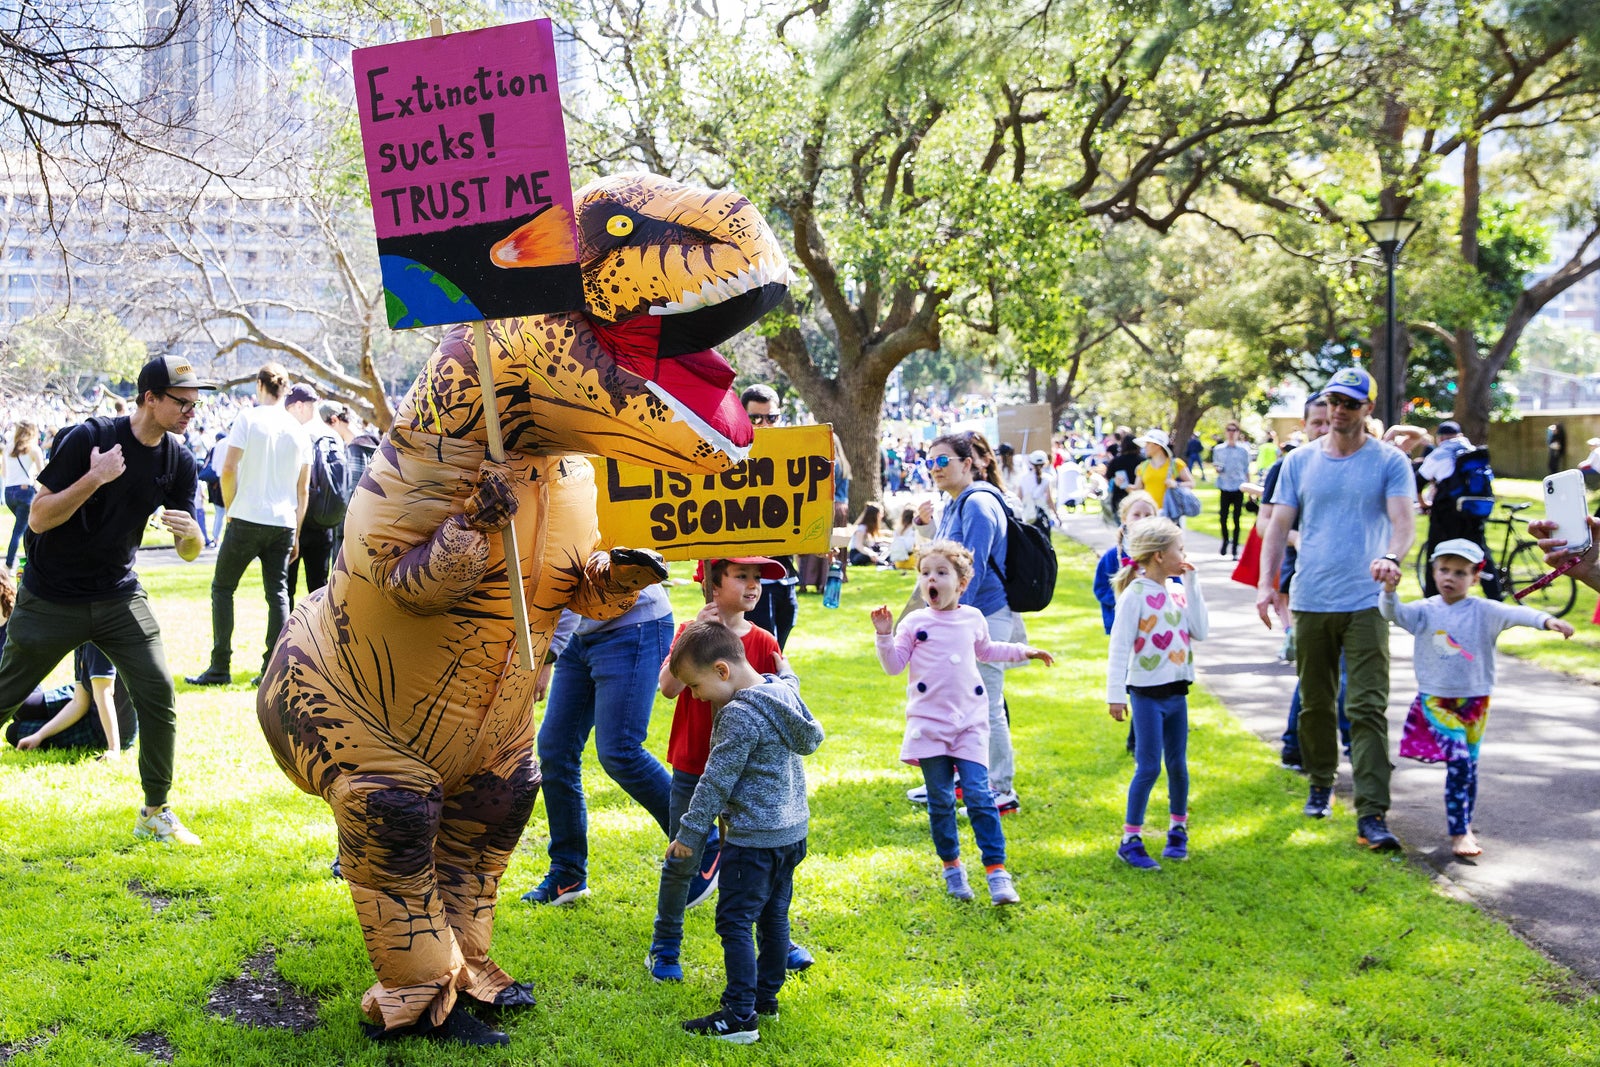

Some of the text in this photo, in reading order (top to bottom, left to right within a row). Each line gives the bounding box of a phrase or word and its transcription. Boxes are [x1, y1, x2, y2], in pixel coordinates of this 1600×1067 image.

[366, 66, 548, 123] Extinction
[378, 112, 496, 174] sucks!
[380, 170, 553, 227] TRUST ME
[714, 1019, 729, 1032] N
